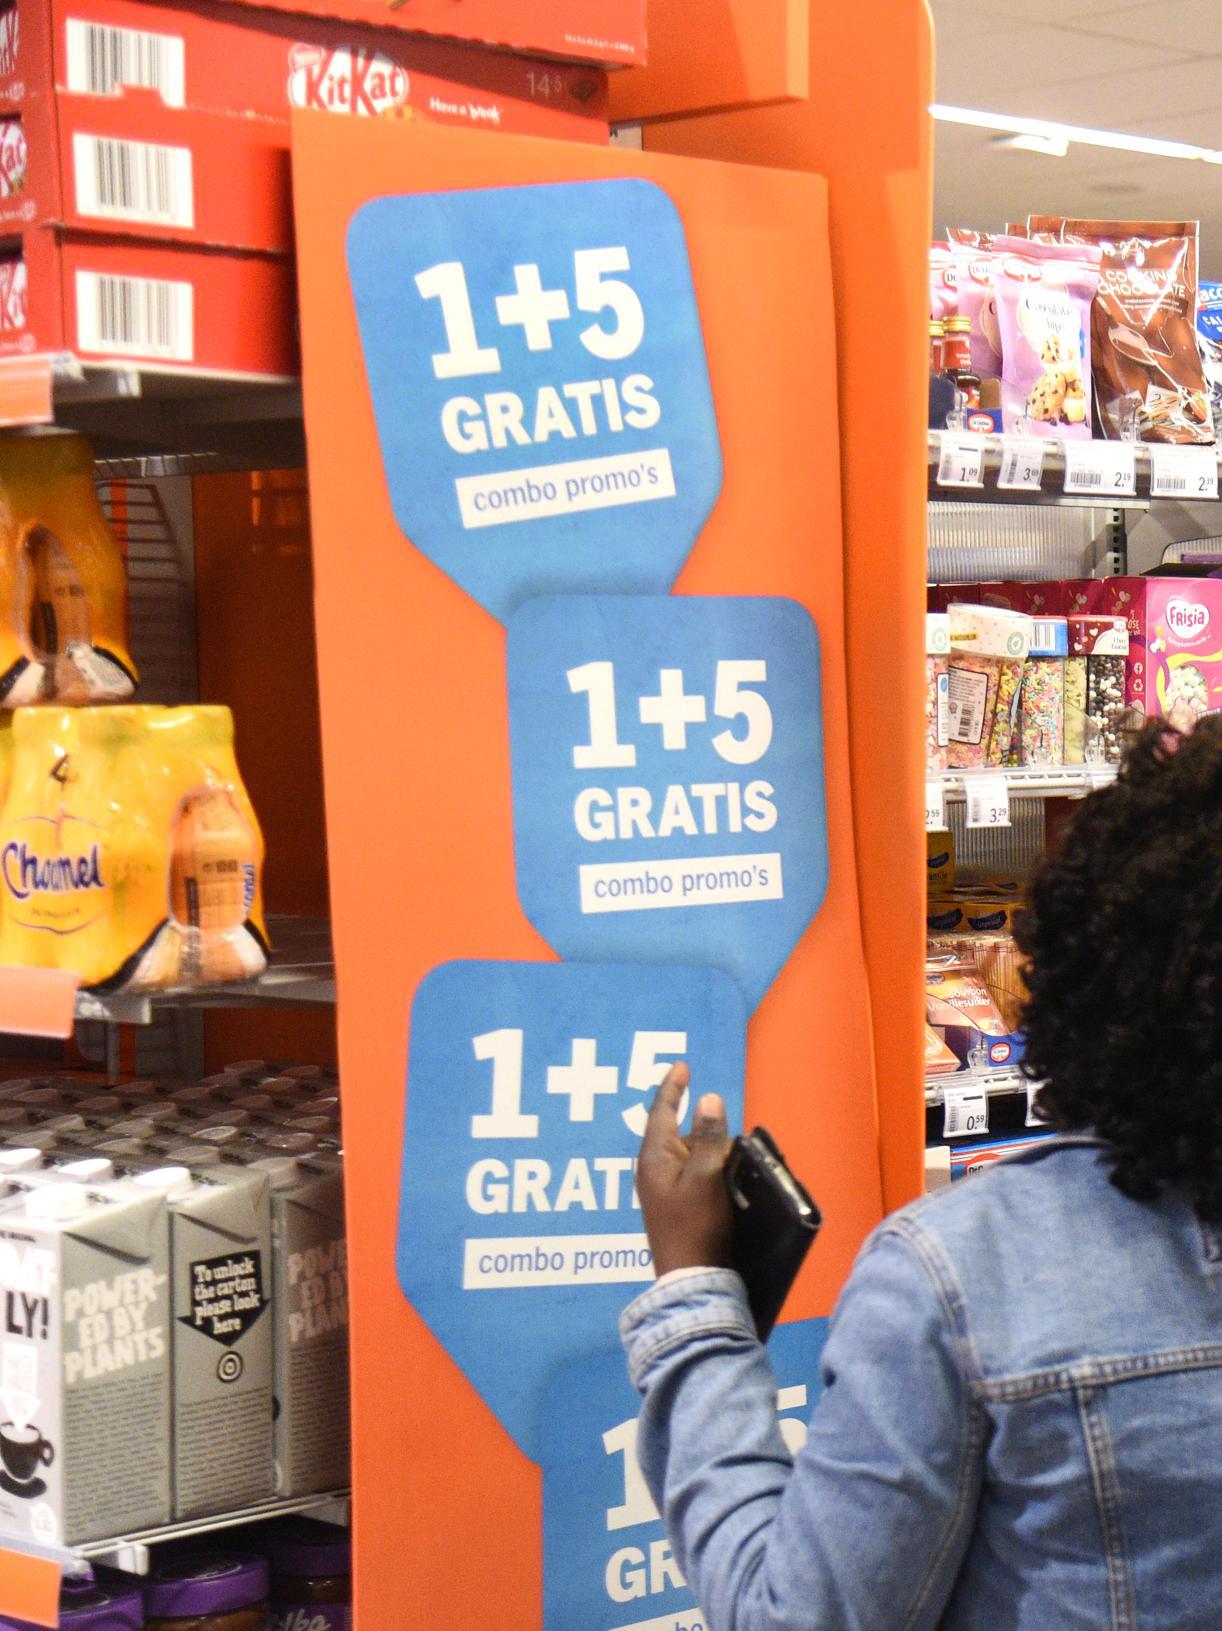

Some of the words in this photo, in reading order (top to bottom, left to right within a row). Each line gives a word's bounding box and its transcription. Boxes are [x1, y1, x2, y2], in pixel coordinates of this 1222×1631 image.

[302, 44, 402, 116] KitKat
[414, 246, 646, 379] 1+5
[439, 373, 661, 455] GRATIS
[472, 477, 558, 512] combo
[564, 463, 659, 501] promo's
[565, 659, 774, 769] 1+5
[573, 779, 779, 842] GRATIS
[593, 871, 674, 899] combo
[681, 865, 769, 897] promo's
[470, 1028, 691, 1139] 1+5
[464, 1155, 642, 1216] GRAT
[193, 1265, 212, 1283] To
[212, 1257, 255, 1280] unlock
[478, 1246, 565, 1275] combo
[573, 1246, 653, 1275] promo
[5, 1290, 49, 1340] LY!
[63, 1268, 168, 1322] POWER-
[193, 1284, 215, 1301] the
[215, 1277, 257, 1297] carton
[193, 1299, 233, 1326] please
[233, 1291, 261, 1311] look
[78, 1312, 110, 1349] ED
[112, 1301, 149, 1338] BY
[211, 1316, 241, 1335] here
[63, 1325, 166, 1384] PLANTS
